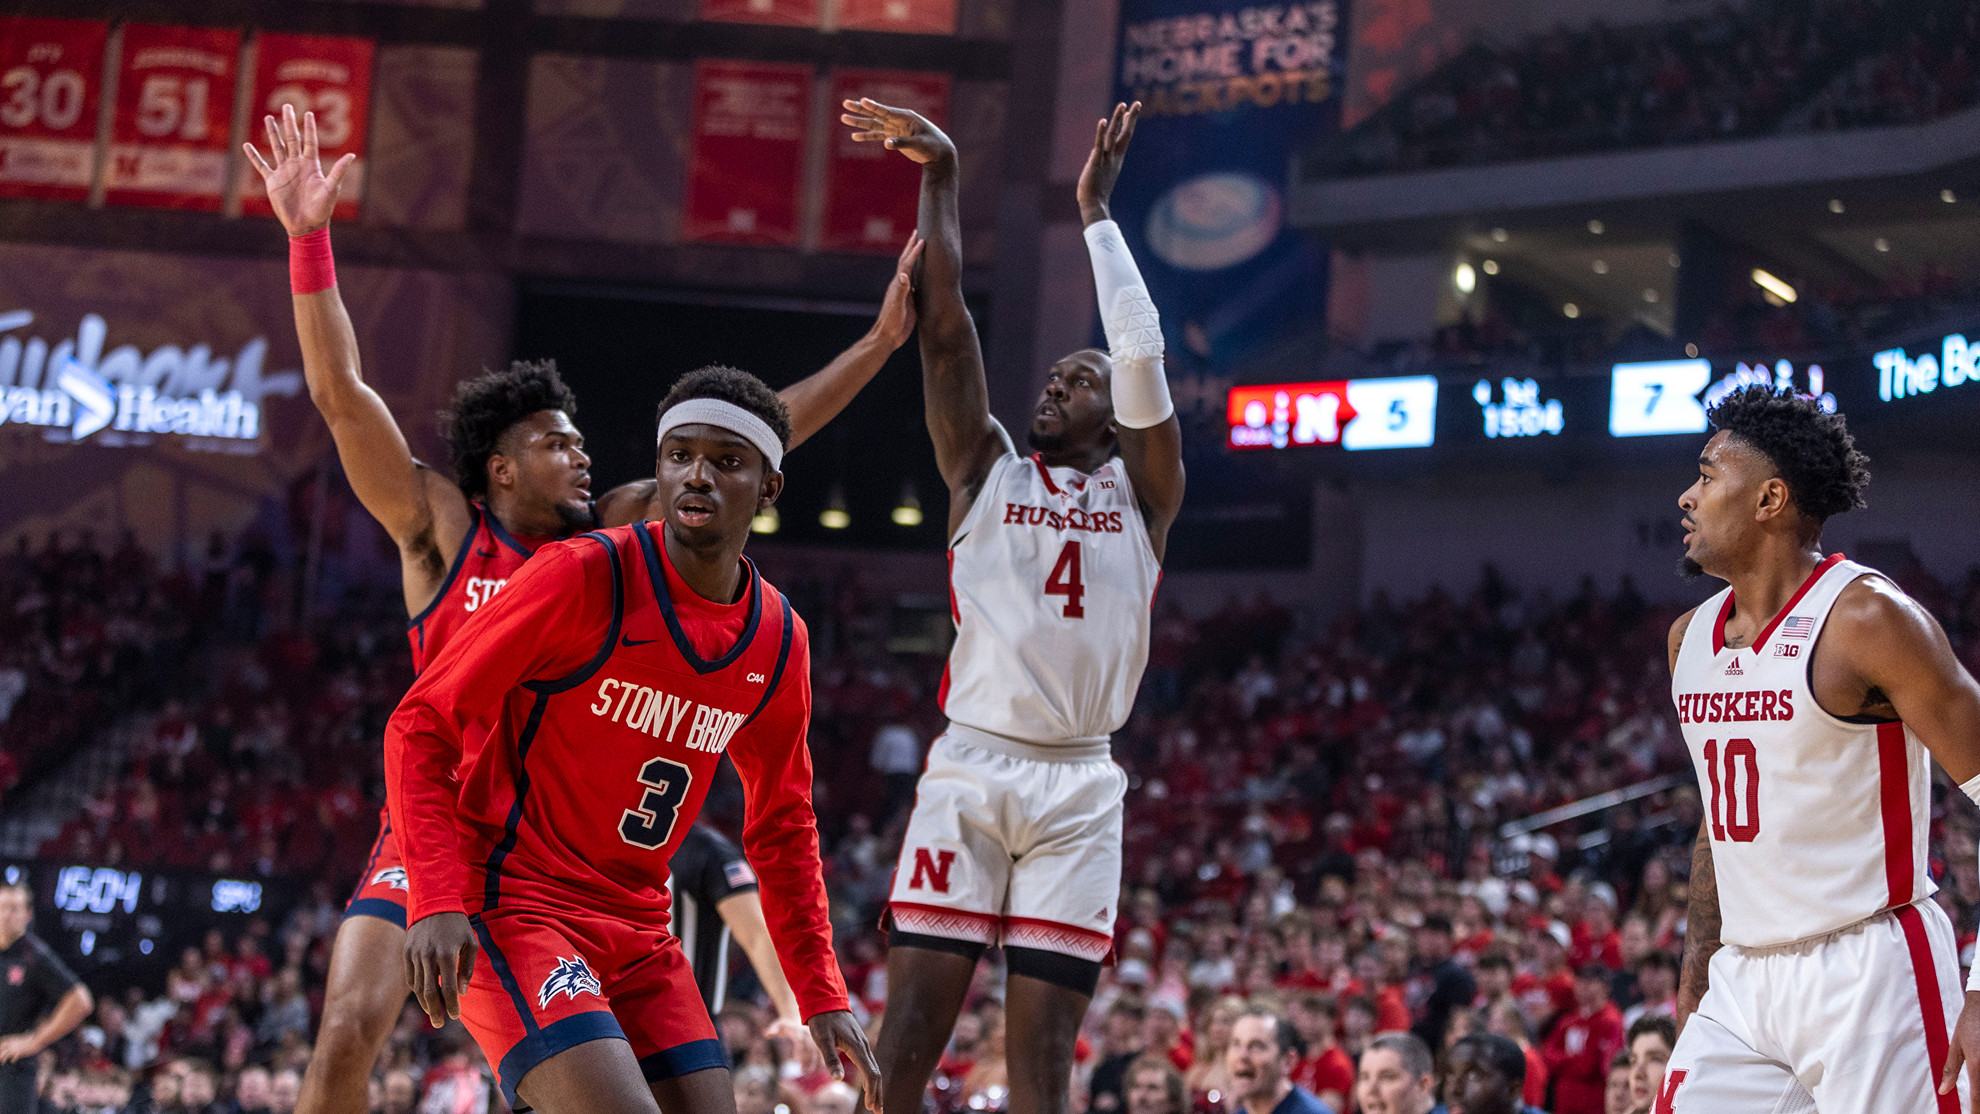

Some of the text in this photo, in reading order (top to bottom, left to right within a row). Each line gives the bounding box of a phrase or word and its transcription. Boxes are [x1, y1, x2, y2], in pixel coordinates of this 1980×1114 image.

[0, 66, 85, 129] 30
[137, 76, 209, 139] 51
[1644, 384, 1663, 416] 7
[1873, 347, 1939, 402] The
[113, 382, 259, 439] Health
[1293, 391, 1340, 443] N
[1387, 399, 1408, 431] 5
[1003, 502, 1123, 534] HUSKERS
[1044, 540, 1085, 620] 4
[590, 678, 748, 754] STONY BROO
[1678, 689, 1795, 724] HUSKERS
[617, 756, 693, 851] 3
[1703, 738, 1760, 842] 10
[908, 846, 956, 894] N
